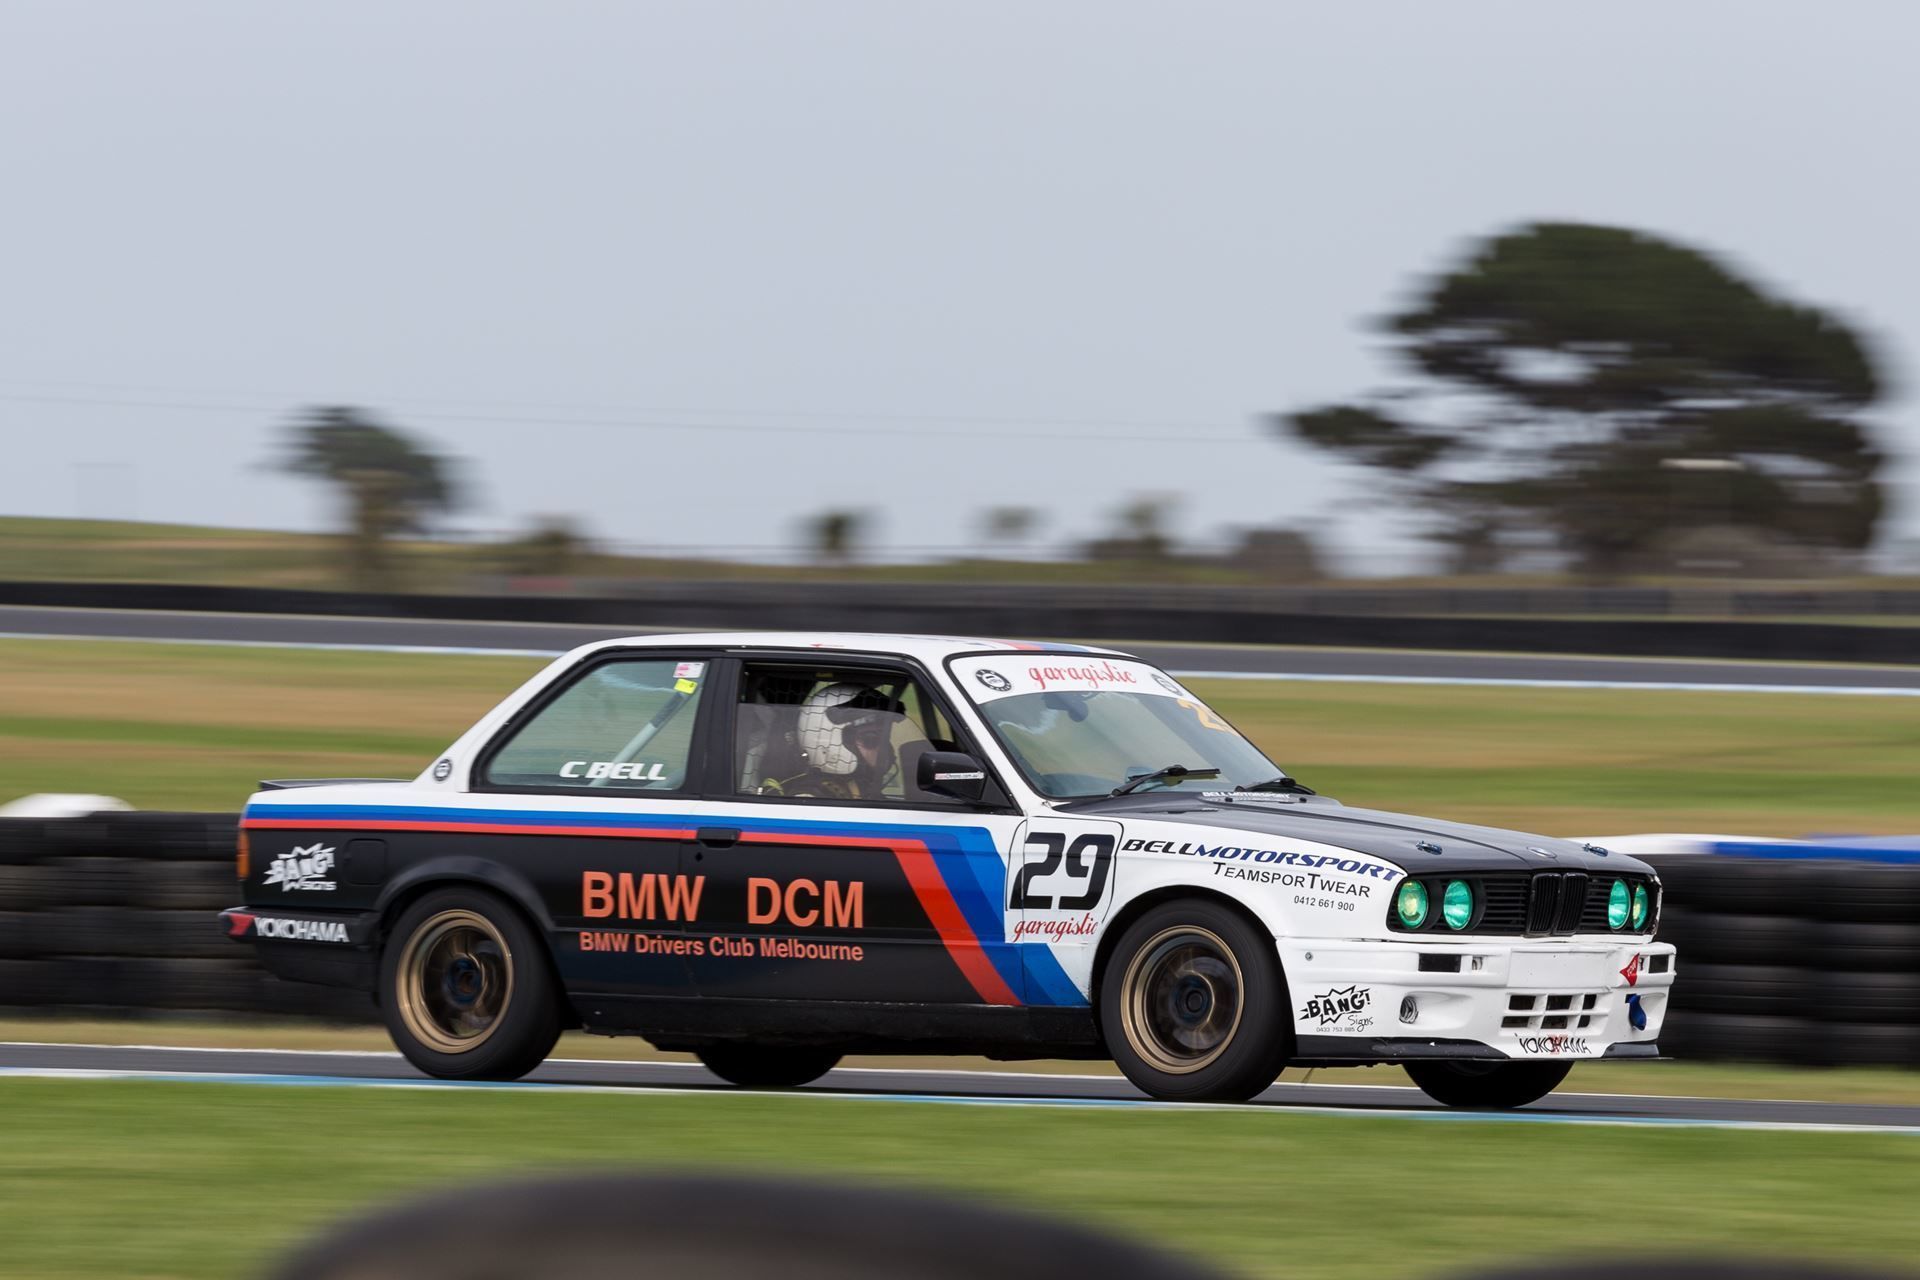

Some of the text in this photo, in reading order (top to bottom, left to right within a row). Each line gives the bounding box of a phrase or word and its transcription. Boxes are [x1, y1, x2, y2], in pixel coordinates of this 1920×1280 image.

[1028, 661, 1137, 690] garagistic
[559, 761, 667, 781] C BELL
[1009, 832, 1115, 911] 29
[582, 870, 864, 929] BMW DCM
[1293, 895, 1356, 912] 0412 661 900
[253, 916, 351, 943] YOKOHAMA
[1013, 912, 1099, 943] garagistic
[579, 931, 864, 961] BMW Drivers Club Melbourne
[1306, 992, 1371, 1019] BANG!
[1347, 1014, 1374, 1033] Signs
[1518, 1036, 1592, 1055] YOKOHAMA
